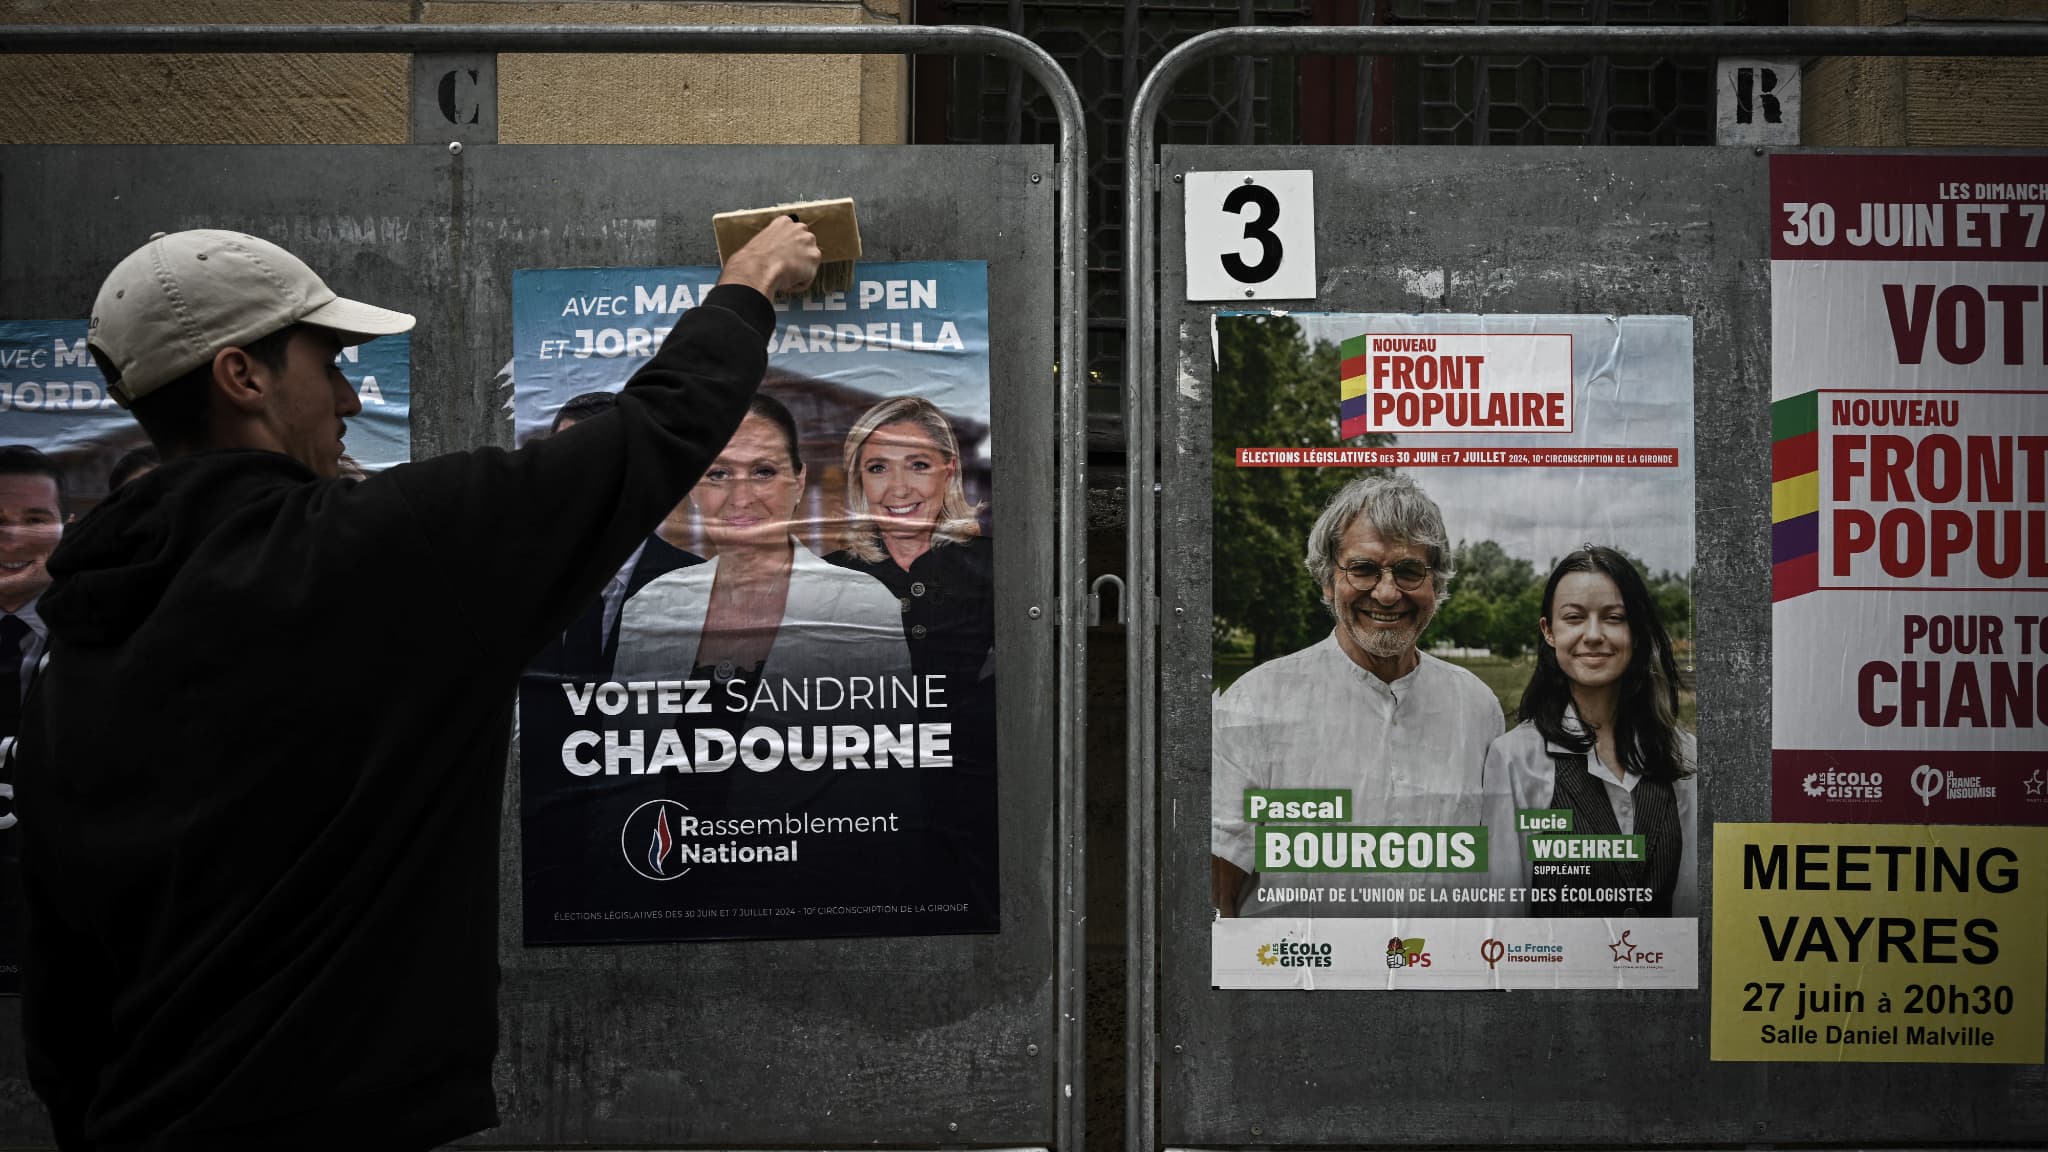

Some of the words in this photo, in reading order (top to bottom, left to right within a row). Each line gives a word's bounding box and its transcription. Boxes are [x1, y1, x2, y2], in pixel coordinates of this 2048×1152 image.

[438, 69, 479, 125] C
[1736, 67, 1783, 124] R
[1939, 182, 1970, 200] LES
[1220, 184, 1284, 284] 3
[1782, 202, 1836, 246] 30
[1845, 203, 1945, 247] JUIN
[1956, 203, 2009, 248] ET
[2019, 204, 2046, 248] 7
[561, 296, 628, 317] AVEC
[859, 279, 937, 310] PEN
[1882, 284, 2048, 365] VOT
[539, 340, 571, 360] ET
[1372, 338, 1437, 352] NOUVEAU
[1372, 355, 1484, 390] FRONT
[1372, 391, 1565, 427] POPULAIRE
[1832, 400, 1959, 427] NOUVEAU
[1242, 450, 1300, 463] ÉLECTIONS
[1303, 450, 1378, 463] LÉGISLATIVES
[1380, 454, 1394, 463] DES
[1396, 452, 1410, 463] 30
[1413, 452, 1438, 463] JUIN
[1441, 454, 1451, 463] ET
[1453, 452, 1460, 463] 7
[1462, 451, 1506, 463] JUILLET
[1509, 454, 1530, 465] 2024,
[1545, 454, 1613, 464] CIRCONSCRIPTION
[1615, 454, 1625, 464] DE
[1627, 454, 1638, 464] LA
[1639, 454, 1673, 464] GIRONDE
[1832, 434, 2048, 503] FRONT
[1833, 508, 2048, 579] POPUL
[1904, 615, 2003, 654] POUR
[561, 680, 713, 716] VOTEZ
[724, 674, 948, 713] SANDRINE
[561, 722, 954, 777] CHADOURNE
[1826, 767, 1883, 786] ÉCOLO
[1946, 777, 1981, 788] FRANCE
[1826, 786, 1883, 798] GISTES
[1946, 786, 1997, 800] INSOUMISE
[1250, 796, 1343, 819] Pascal
[681, 812, 899, 836] Rassemblement
[1520, 814, 1567, 830] Lucie
[681, 840, 798, 864] National
[1265, 832, 1476, 869] BOURGOIS
[1532, 839, 1639, 859] WOEHREL
[1533, 863, 1591, 875] SUPPLÉANTE
[1743, 844, 2019, 893] MEETING
[1257, 887, 1324, 903] CANDIDAT
[1329, 887, 1346, 902] DE
[1351, 887, 1404, 903] L'UNION
[1409, 887, 1426, 902] DE
[1430, 887, 1448, 902] LA
[1452, 887, 1505, 902] GAUCHE
[1509, 888, 1527, 902] ET
[1531, 888, 1557, 902] DES
[1561, 884, 1653, 902] ÉCOLOGISTES
[554, 910, 601, 920] ÉLECTIONS
[604, 909, 663, 920] LÉGISLATIVES
[665, 910, 682, 919] DES
[817, 905, 898, 915] CIRCONSCRIPTION
[900, 904, 913, 913] DE
[914, 904, 926, 913] LA
[927, 903, 969, 913] GIRONDE
[1280, 938, 1332, 955] ÉCOLO
[1507, 943, 1522, 953] La
[1525, 943, 1563, 953] France
[1758, 916, 1999, 964] VAYRES
[1280, 956, 1332, 968] GISTES
[1408, 953, 1431, 968] PS
[1507, 953, 1563, 963] insoumise
[1636, 952, 1663, 964] PCF
[1742, 983, 1785, 1012] 27
[1795, 983, 1864, 1020] juin
[1877, 993, 1892, 1013] à
[1904, 985, 2014, 1015] 20h30
[1760, 1024, 1818, 1044] Salle
[1826, 1025, 1898, 1045] Daniel
[1906, 1026, 1994, 1046] Malville
